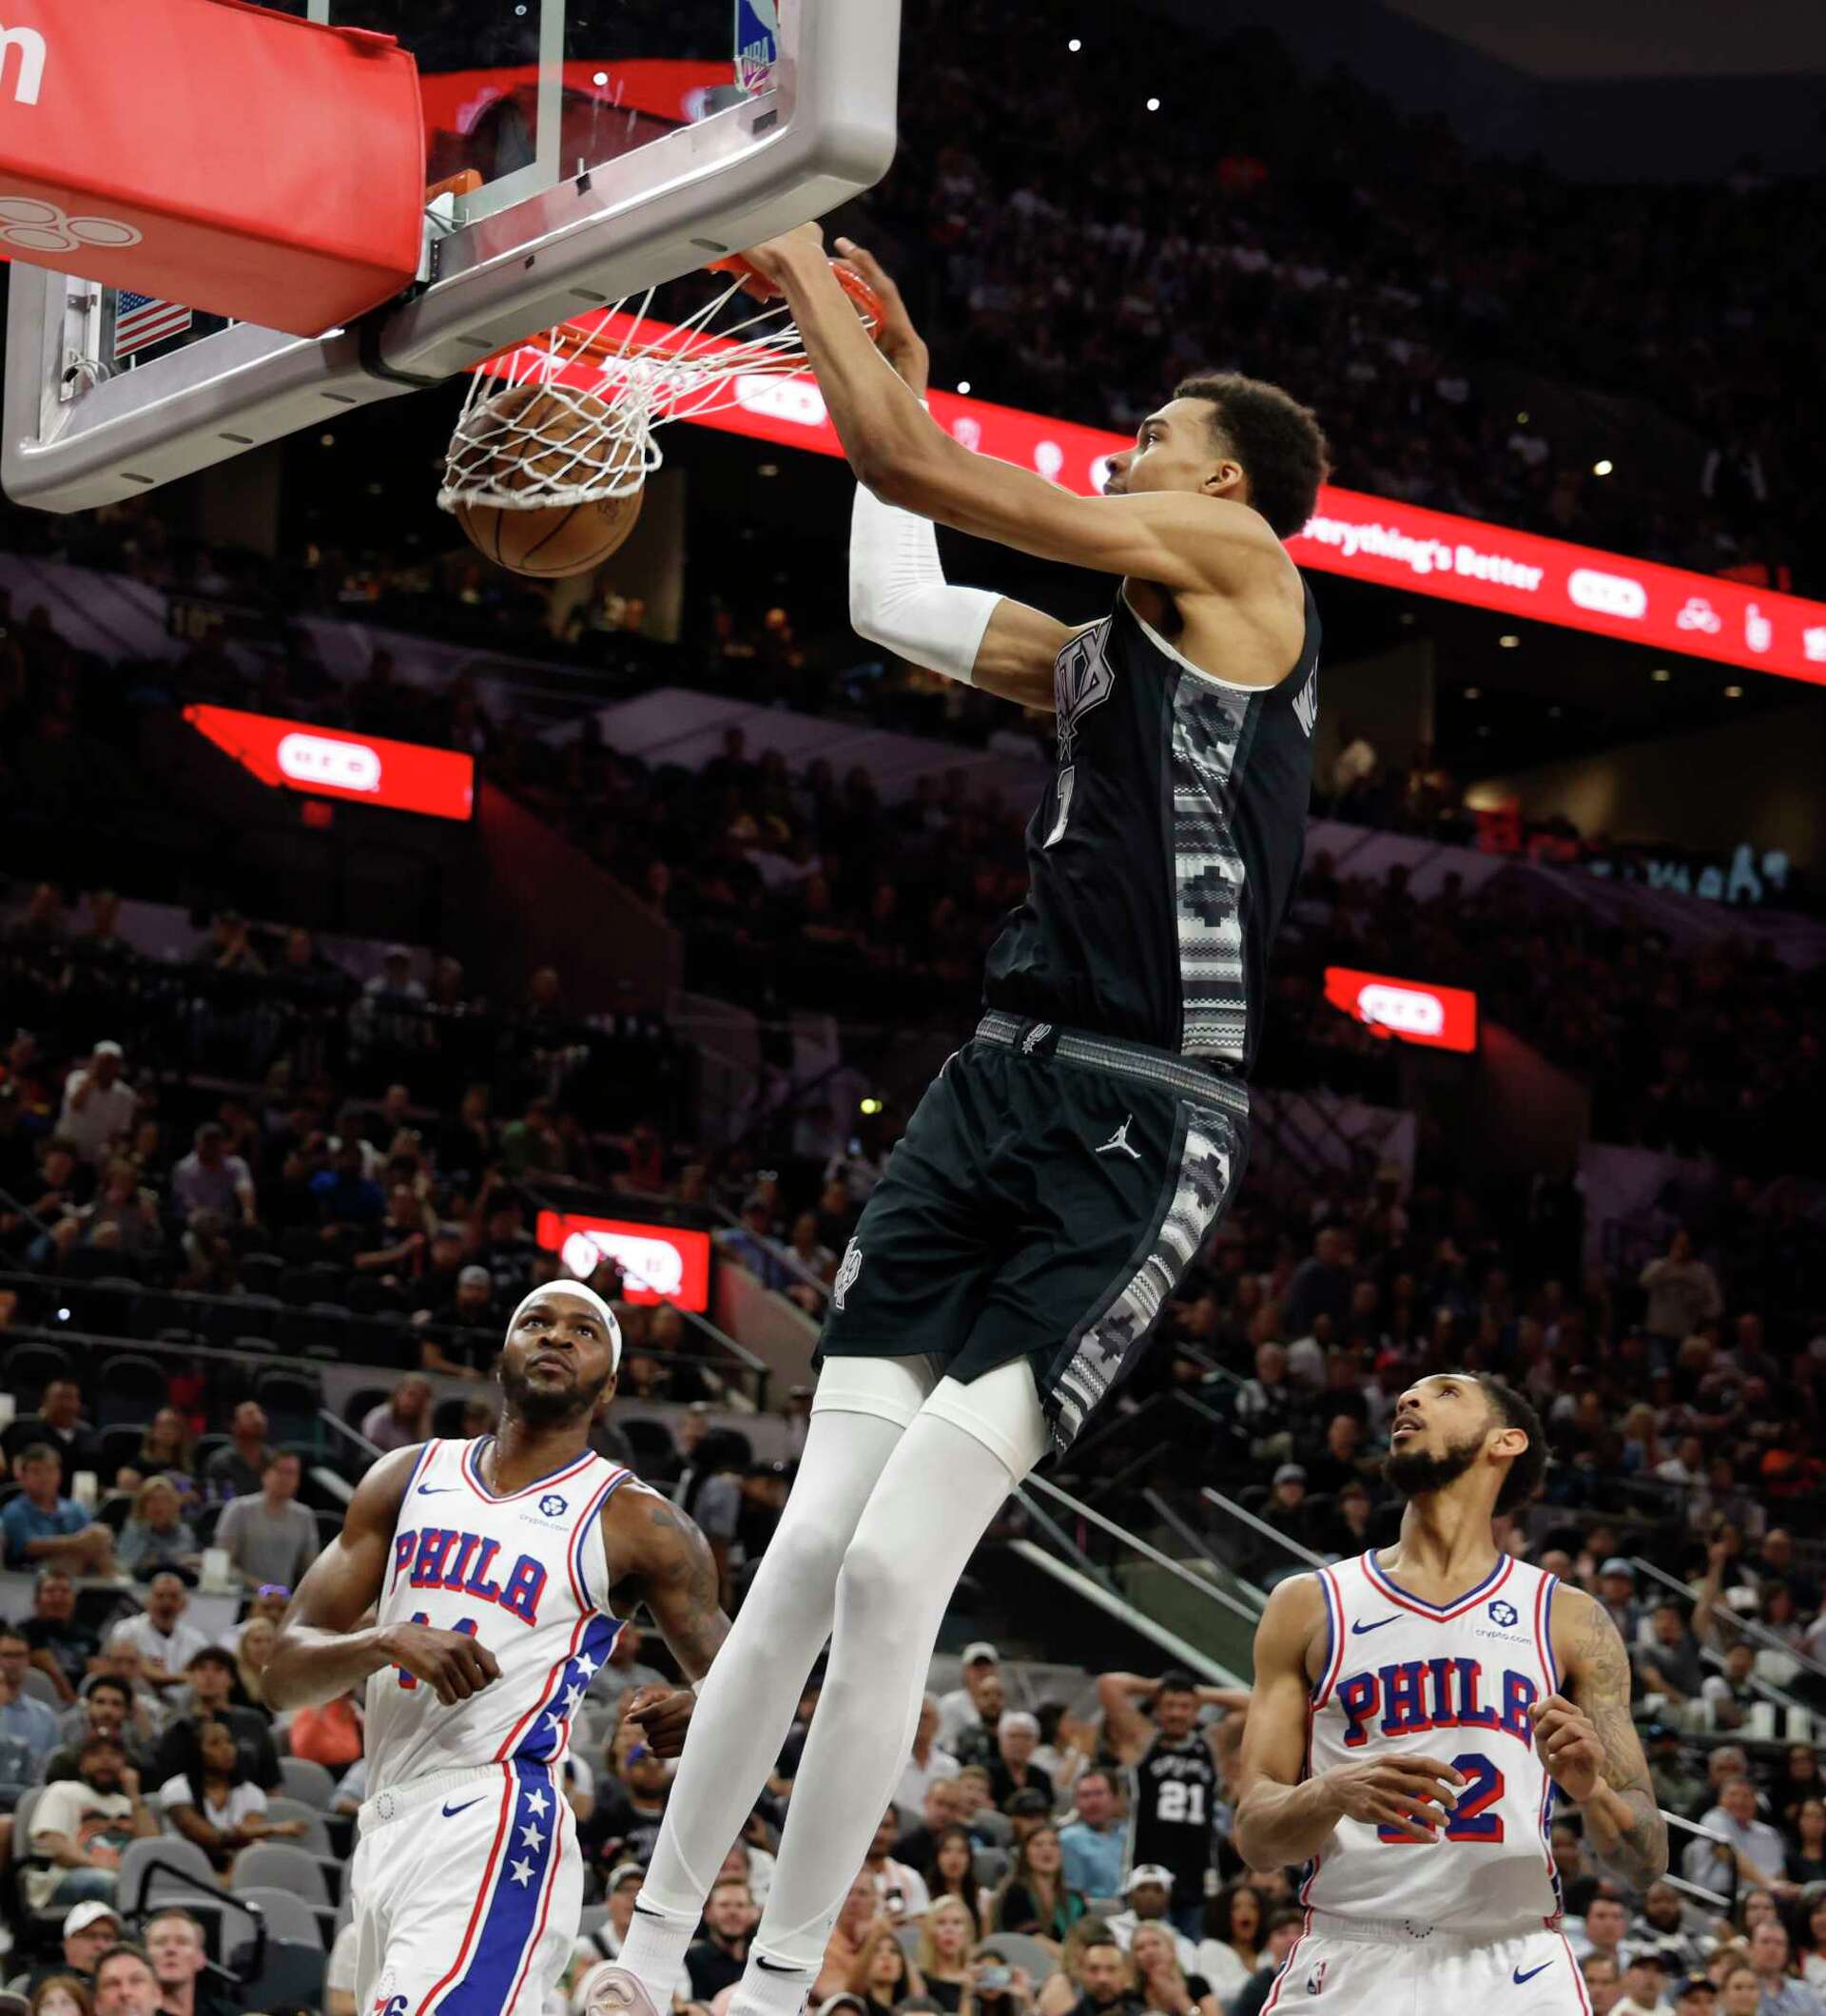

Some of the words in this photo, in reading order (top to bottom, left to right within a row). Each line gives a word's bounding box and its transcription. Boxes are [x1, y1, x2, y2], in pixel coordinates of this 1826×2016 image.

[1043, 765, 1075, 848] 1
[390, 1527, 548, 1628] PHILA
[1475, 1629, 1532, 1646] crypto.com
[1336, 1657, 1538, 1752] PHILA
[1157, 1780, 1205, 1825] 21
